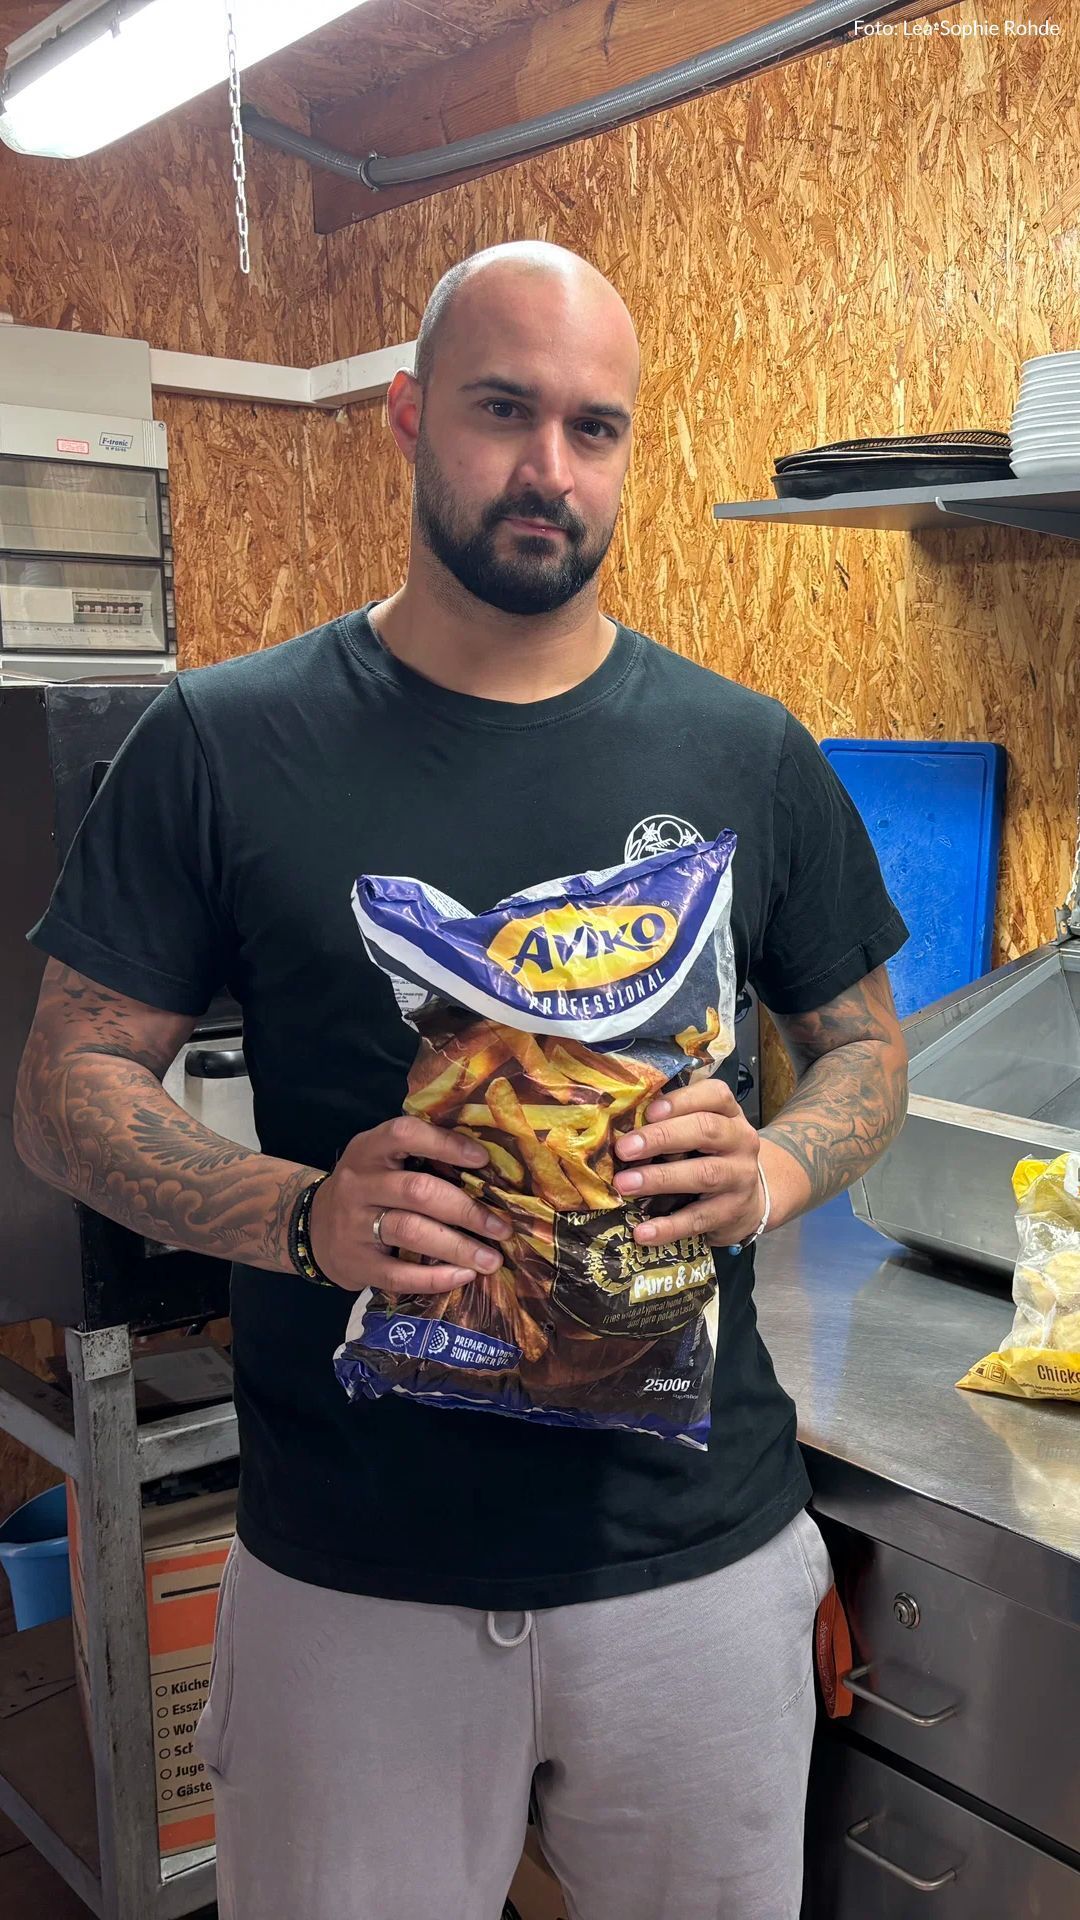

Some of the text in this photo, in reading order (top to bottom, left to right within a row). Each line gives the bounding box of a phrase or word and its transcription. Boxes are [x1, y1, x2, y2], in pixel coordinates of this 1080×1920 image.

[529, 968, 666, 1016] PROFESSIONAL
[634, 1274, 673, 1299] Pure
[675, 1265, 687, 1289] &
[454, 1334, 488, 1353] PREPARED
[488, 1345, 496, 1356] IN
[450, 1346, 496, 1367] SUNFLOWER
[643, 1377, 691, 1392] 2500g
[171, 1678, 209, 1696] Küche
[176, 1780, 213, 1798] Gäste
